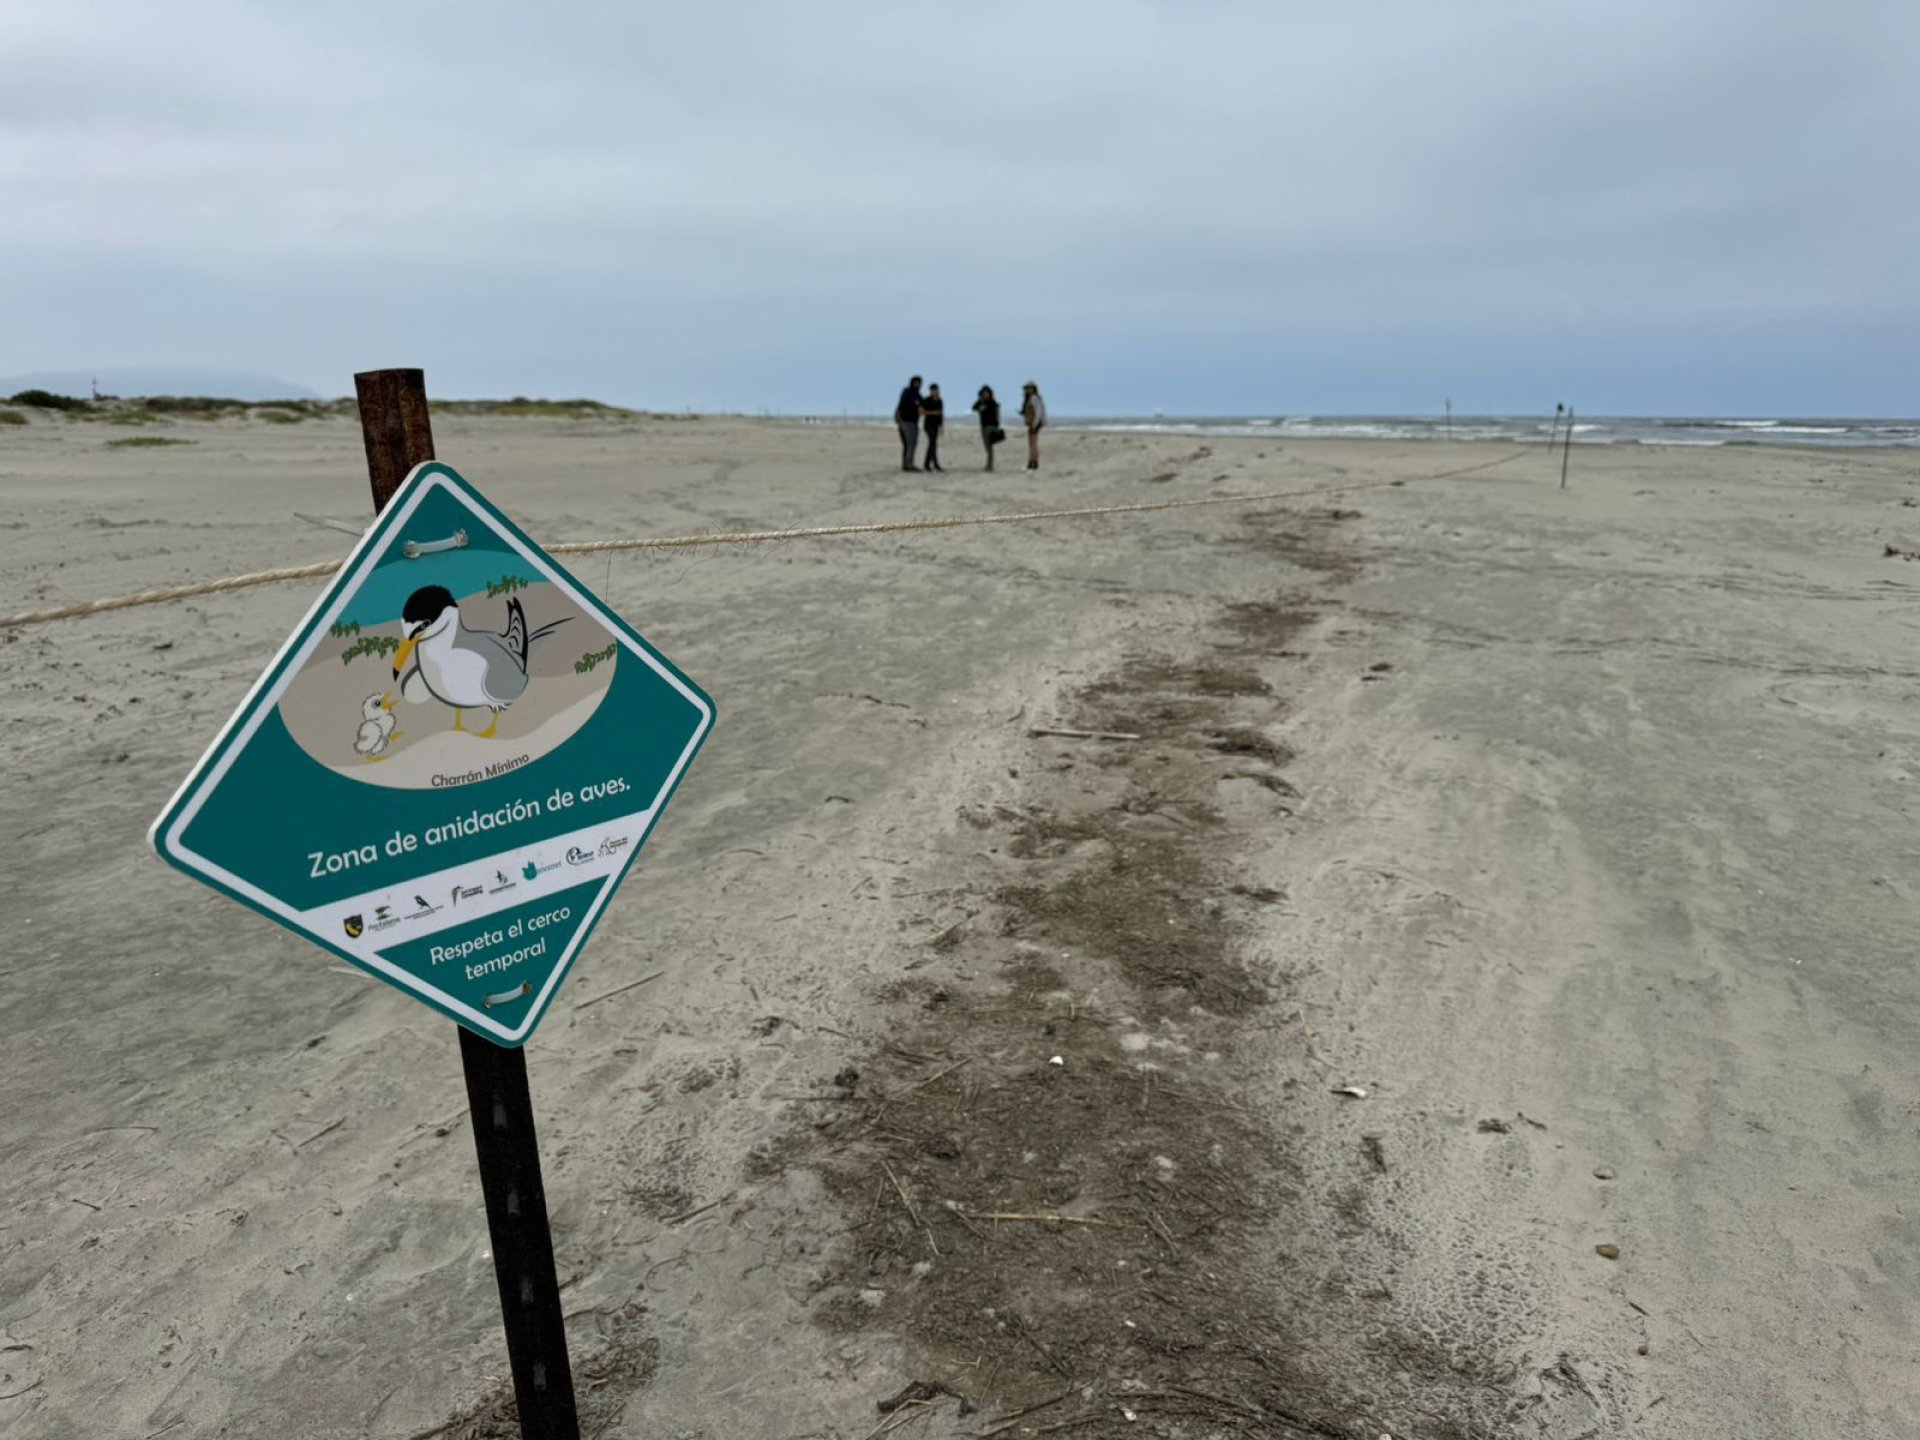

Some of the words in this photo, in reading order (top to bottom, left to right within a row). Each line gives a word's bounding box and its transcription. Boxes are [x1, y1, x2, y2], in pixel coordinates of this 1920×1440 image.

[431, 767, 483, 788] Charrán
[486, 752, 529, 780] Mínimo
[307, 844, 378, 878] Zona
[385, 830, 417, 855] de
[425, 800, 541, 844] anidación
[547, 788, 574, 811] de
[579, 775, 630, 802] aves.
[430, 930, 503, 966] Respeta
[508, 917, 523, 937] el
[528, 905, 570, 931] cerco
[465, 938, 546, 980] temporal
